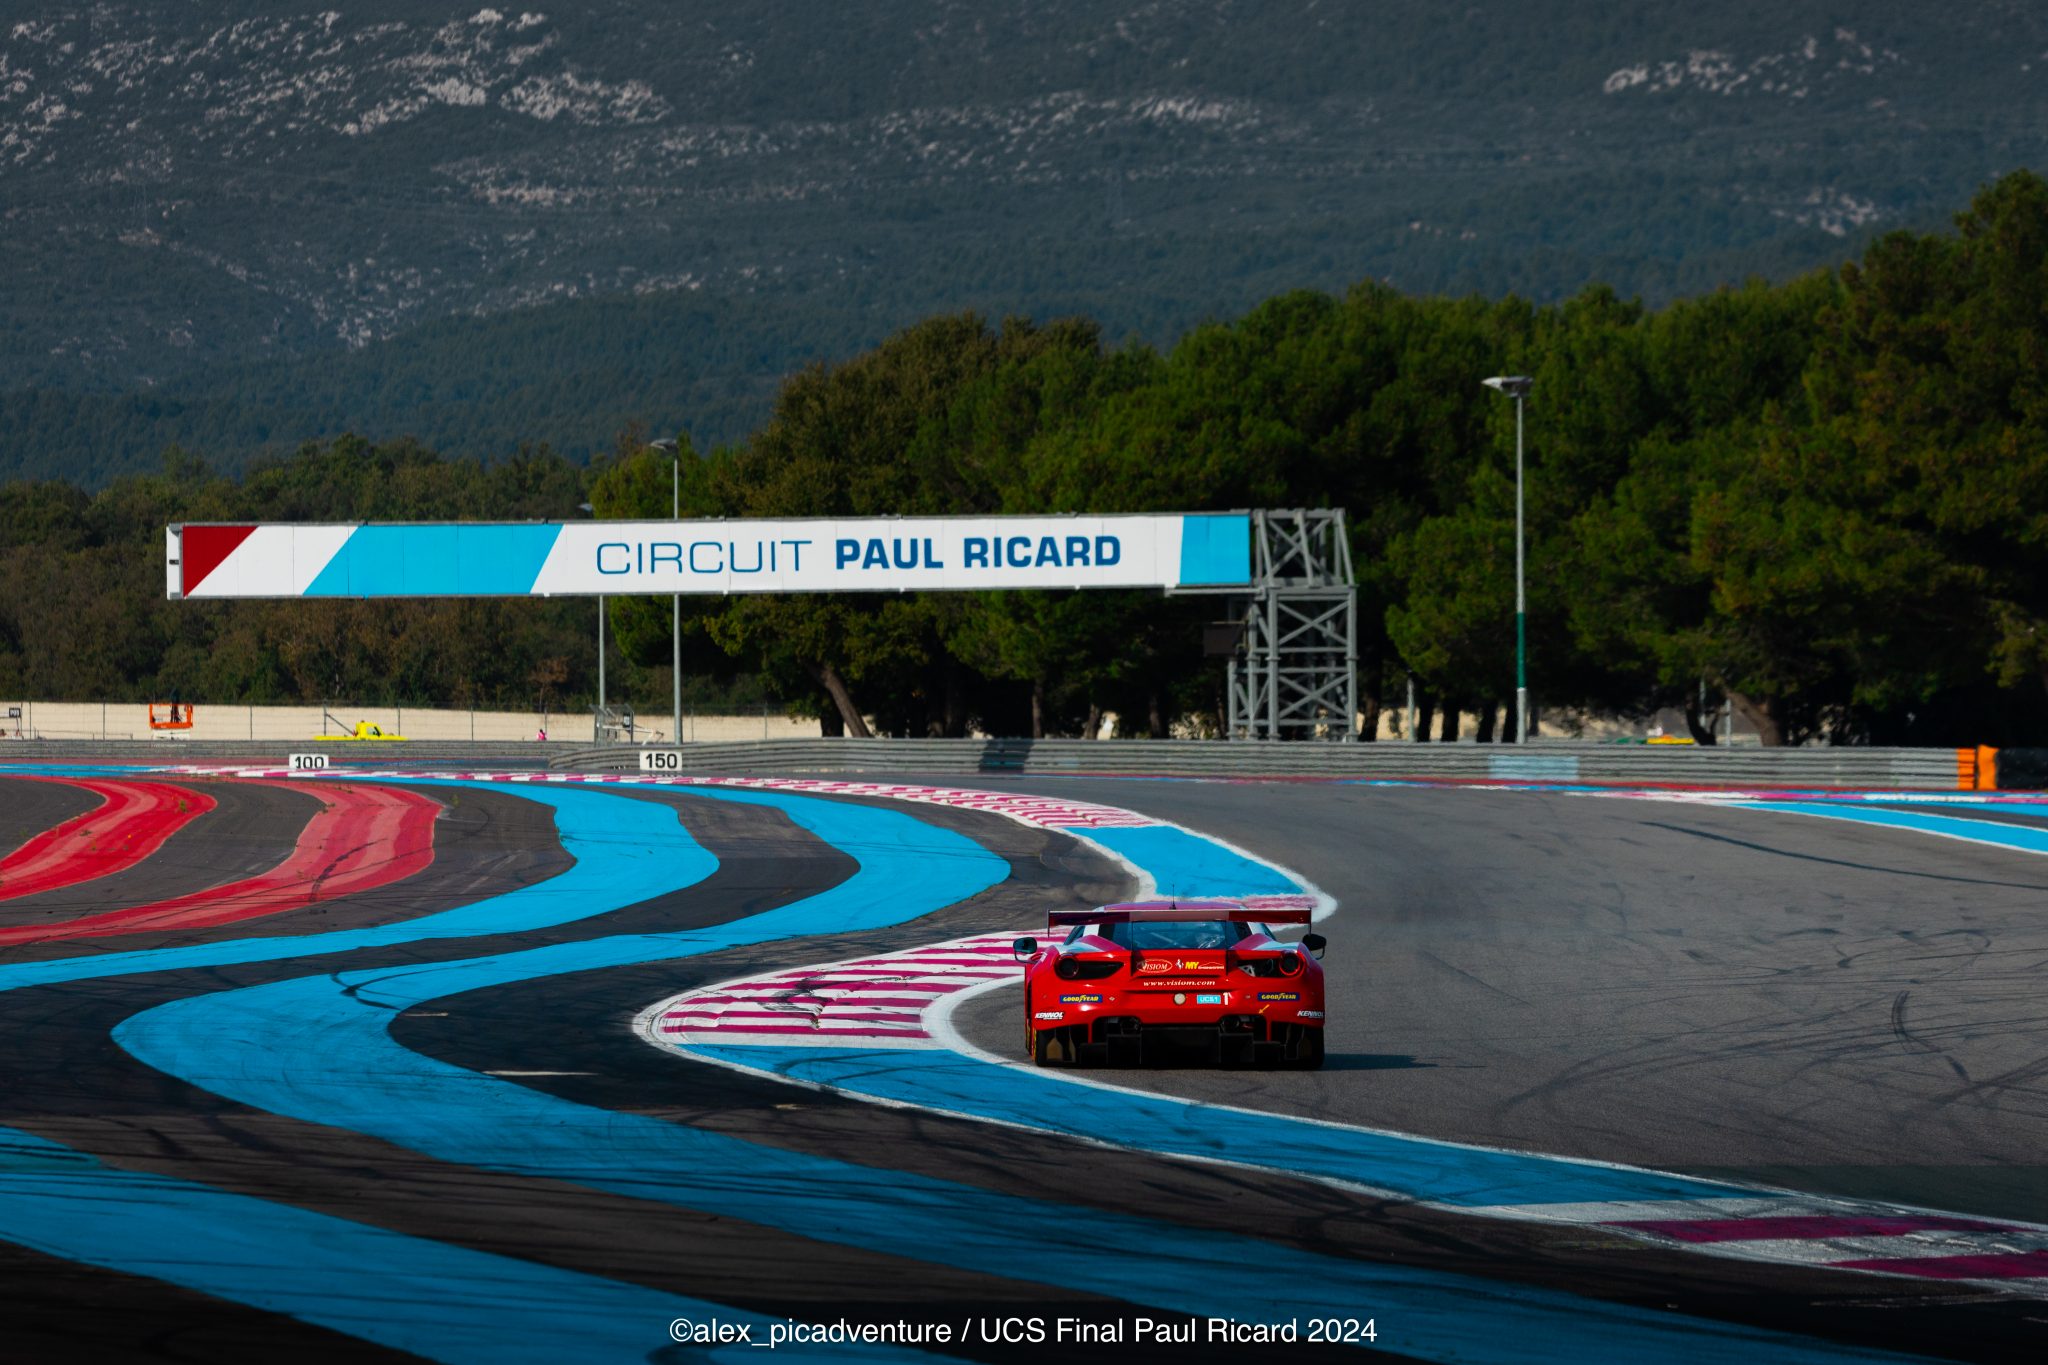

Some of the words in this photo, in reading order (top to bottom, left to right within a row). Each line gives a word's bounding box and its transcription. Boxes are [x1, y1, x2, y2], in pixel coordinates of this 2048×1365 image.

[596, 540, 813, 575] CIRCUIT
[835, 537, 945, 571] PAUL
[963, 535, 1121, 569] RICARD
[295, 756, 324, 769] 100
[646, 753, 677, 769] 150
[1143, 979, 1216, 987] www.visiom.com
[1063, 995, 1099, 1003] GOODYEAR
[1261, 993, 1297, 1001] GOODYEAR
